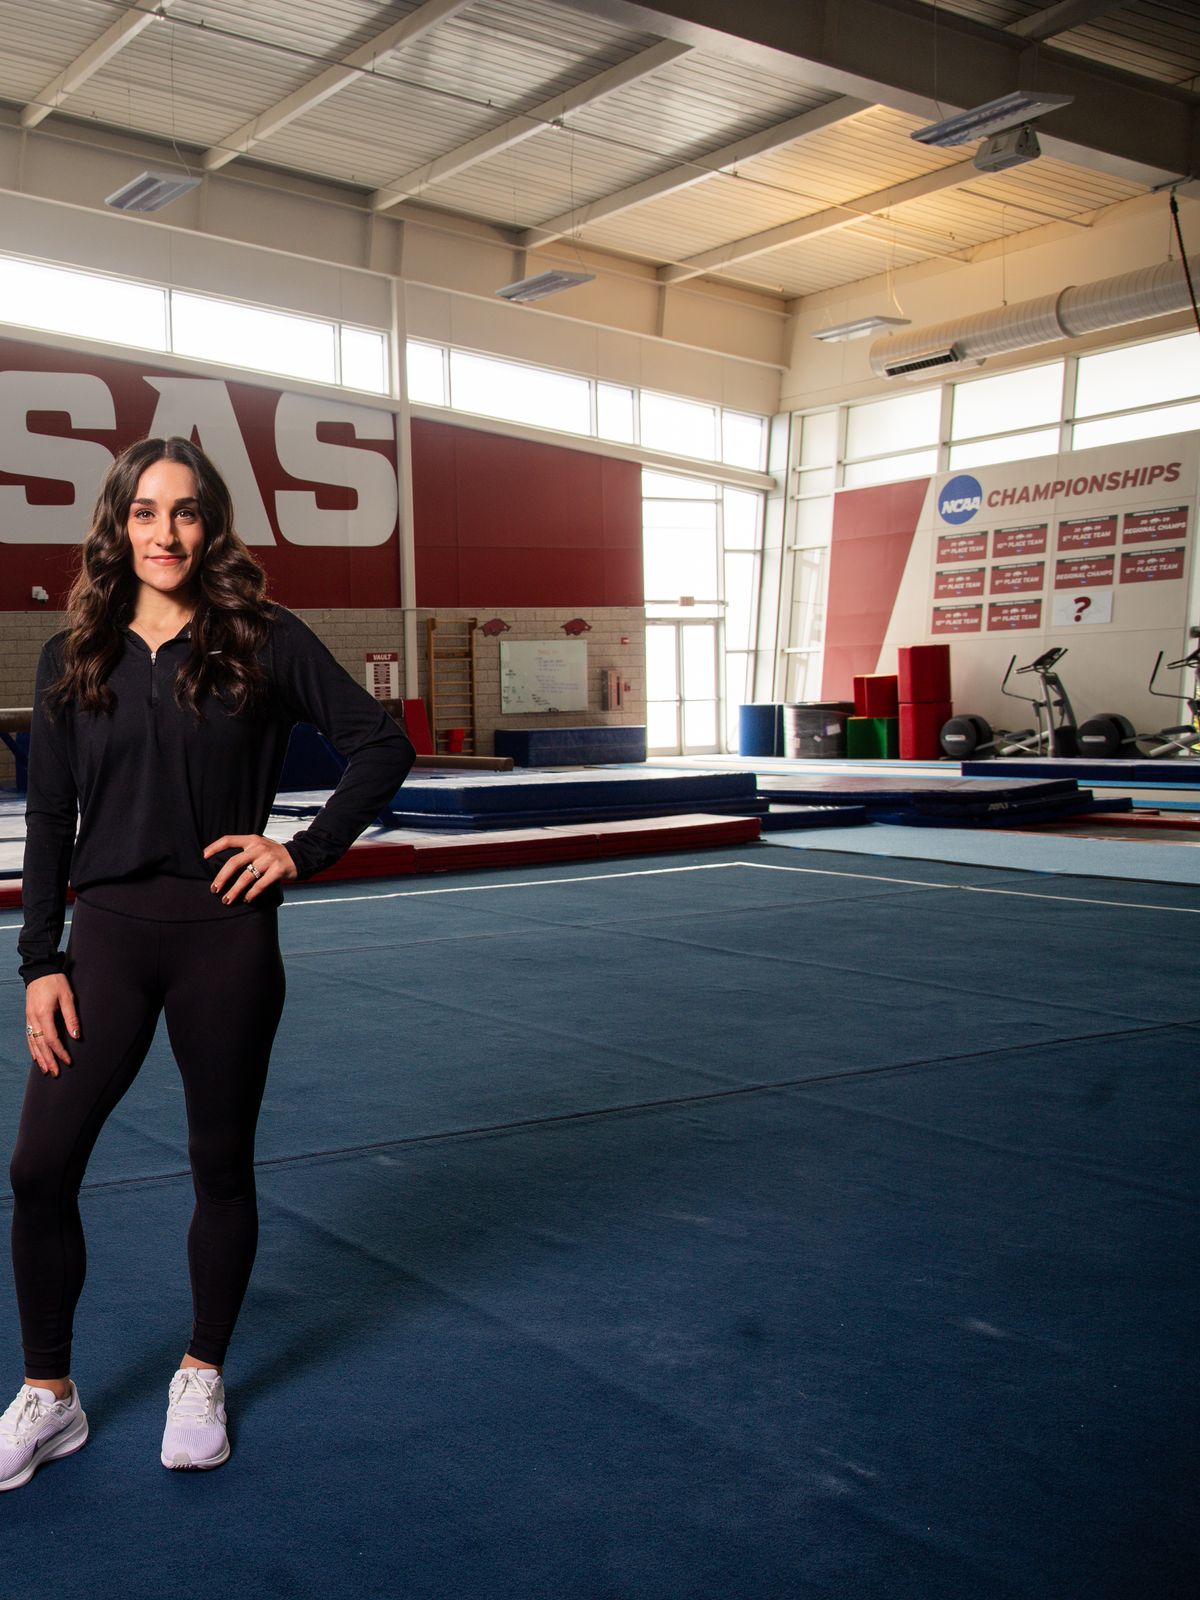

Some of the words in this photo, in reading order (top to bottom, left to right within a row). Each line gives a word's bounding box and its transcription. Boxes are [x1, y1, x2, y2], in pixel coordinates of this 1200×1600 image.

[941, 496, 981, 515] NCAA
[987, 462, 1182, 508] CHAMPIONSHIPS
[1159, 563, 1178, 571] TEAM
[1073, 596, 1091, 622] ?
[372, 653, 392, 661] VAULT
